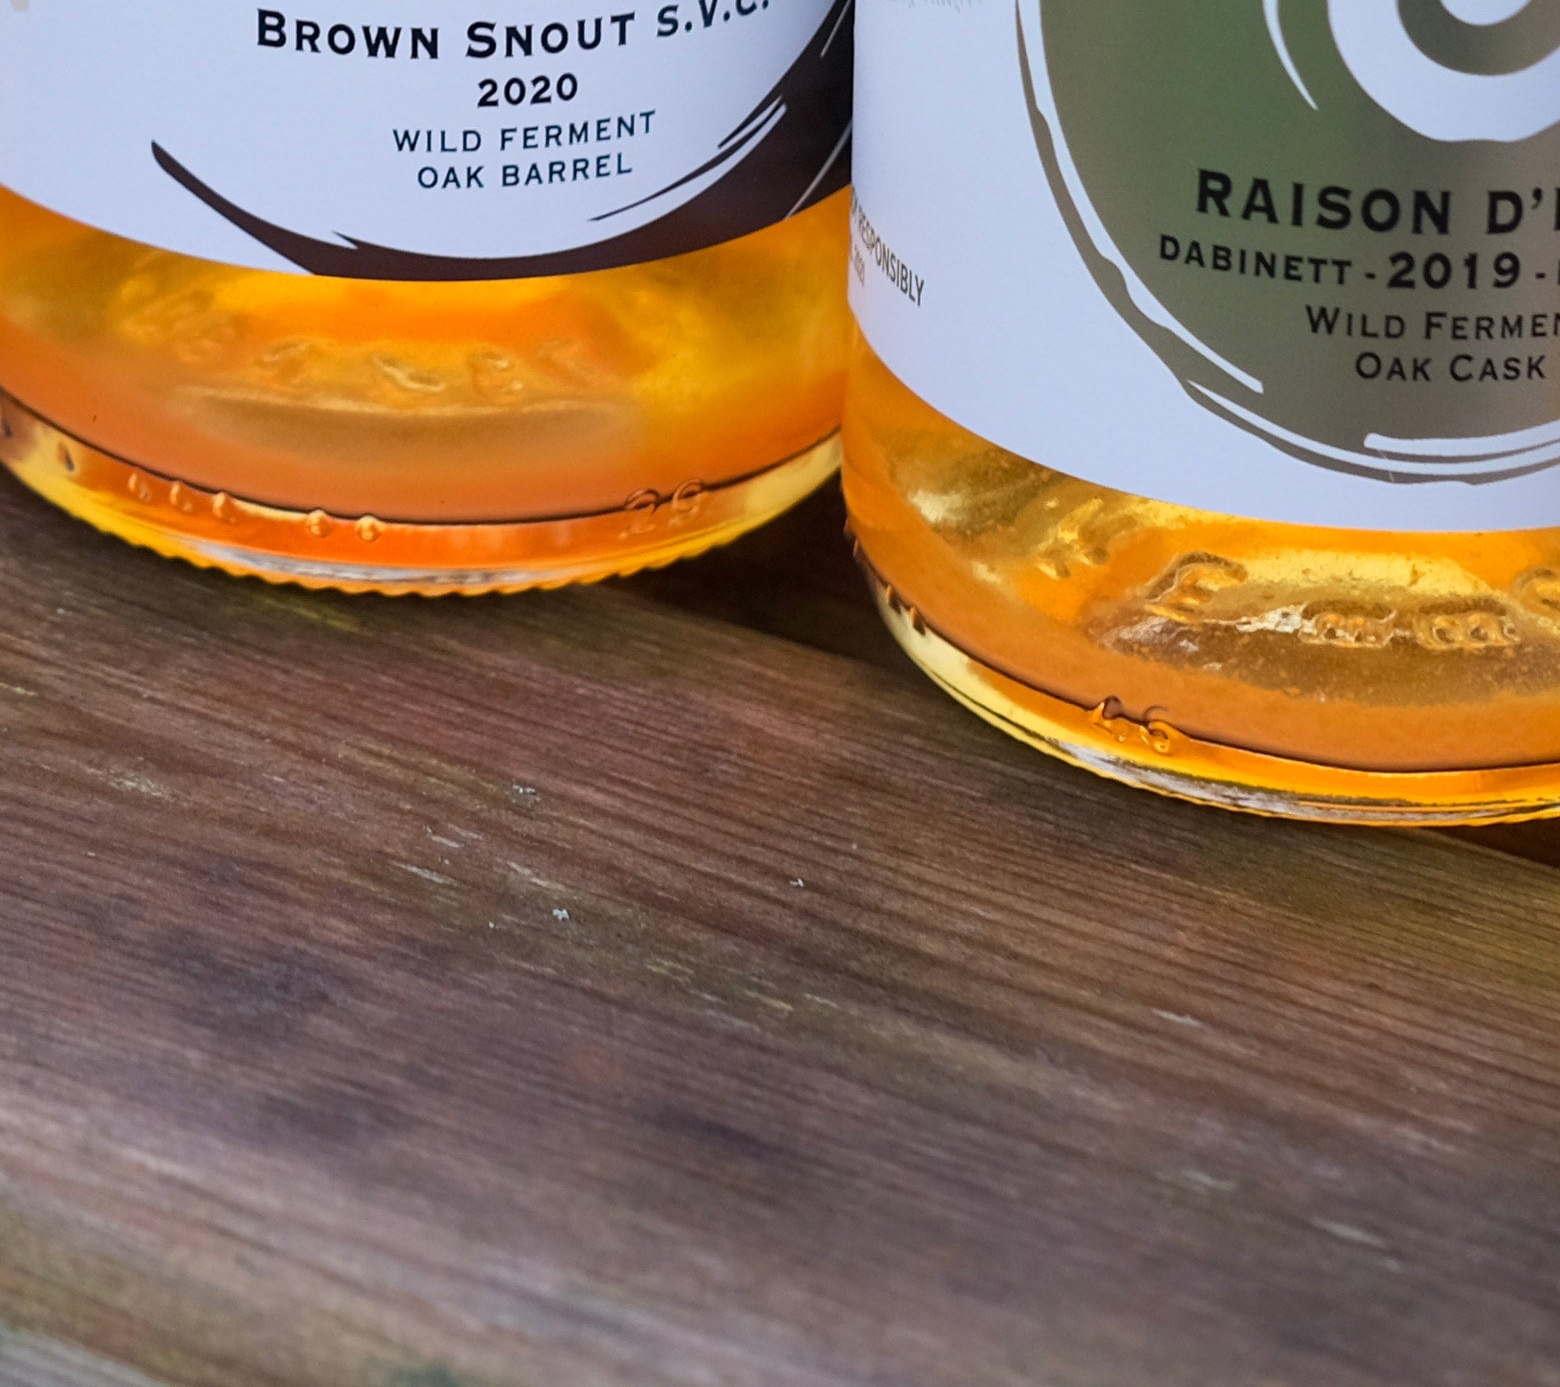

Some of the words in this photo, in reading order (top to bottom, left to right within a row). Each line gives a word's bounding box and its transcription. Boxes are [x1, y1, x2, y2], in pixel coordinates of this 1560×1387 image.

[256, 7, 439, 60] BROWN
[465, 10, 636, 59] SNOUT
[476, 72, 578, 108] 2020
[392, 128, 482, 153] WILD
[499, 109, 657, 152] FERMENT
[417, 165, 485, 189] OAK
[502, 152, 633, 187] BARREL
[1196, 167, 1451, 234] RAISON
[1159, 233, 1352, 285] DABINETT
[1386, 251, 1521, 290] 2019
[1305, 305, 1406, 340] WILD
[1355, 352, 1432, 382] OAK
[1449, 353, 1547, 382] CASK
